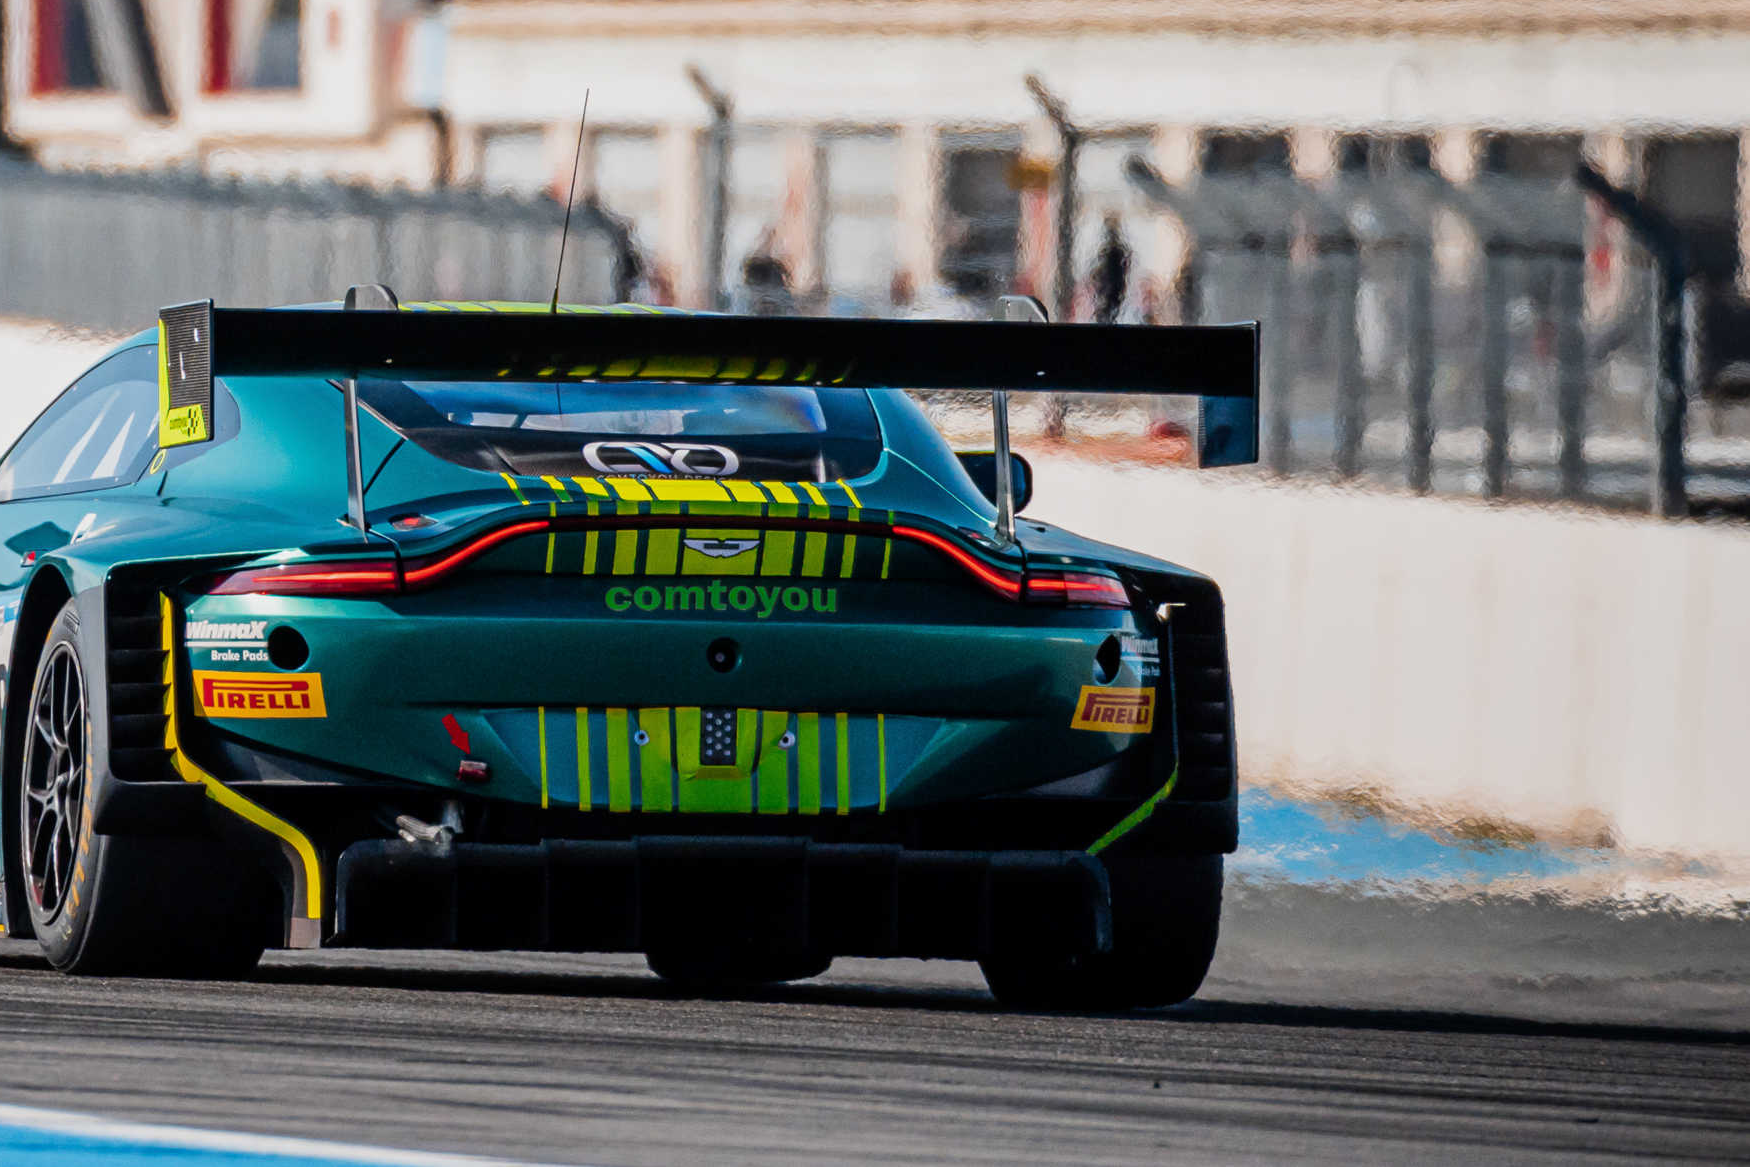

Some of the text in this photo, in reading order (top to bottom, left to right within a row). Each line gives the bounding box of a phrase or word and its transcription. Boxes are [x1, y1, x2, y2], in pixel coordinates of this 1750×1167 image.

[604, 579, 838, 619] comtoyou
[211, 650, 268, 661] Brake Pads
[202, 678, 311, 709] PIRELLI
[1080, 692, 1151, 725] PIRELLI
